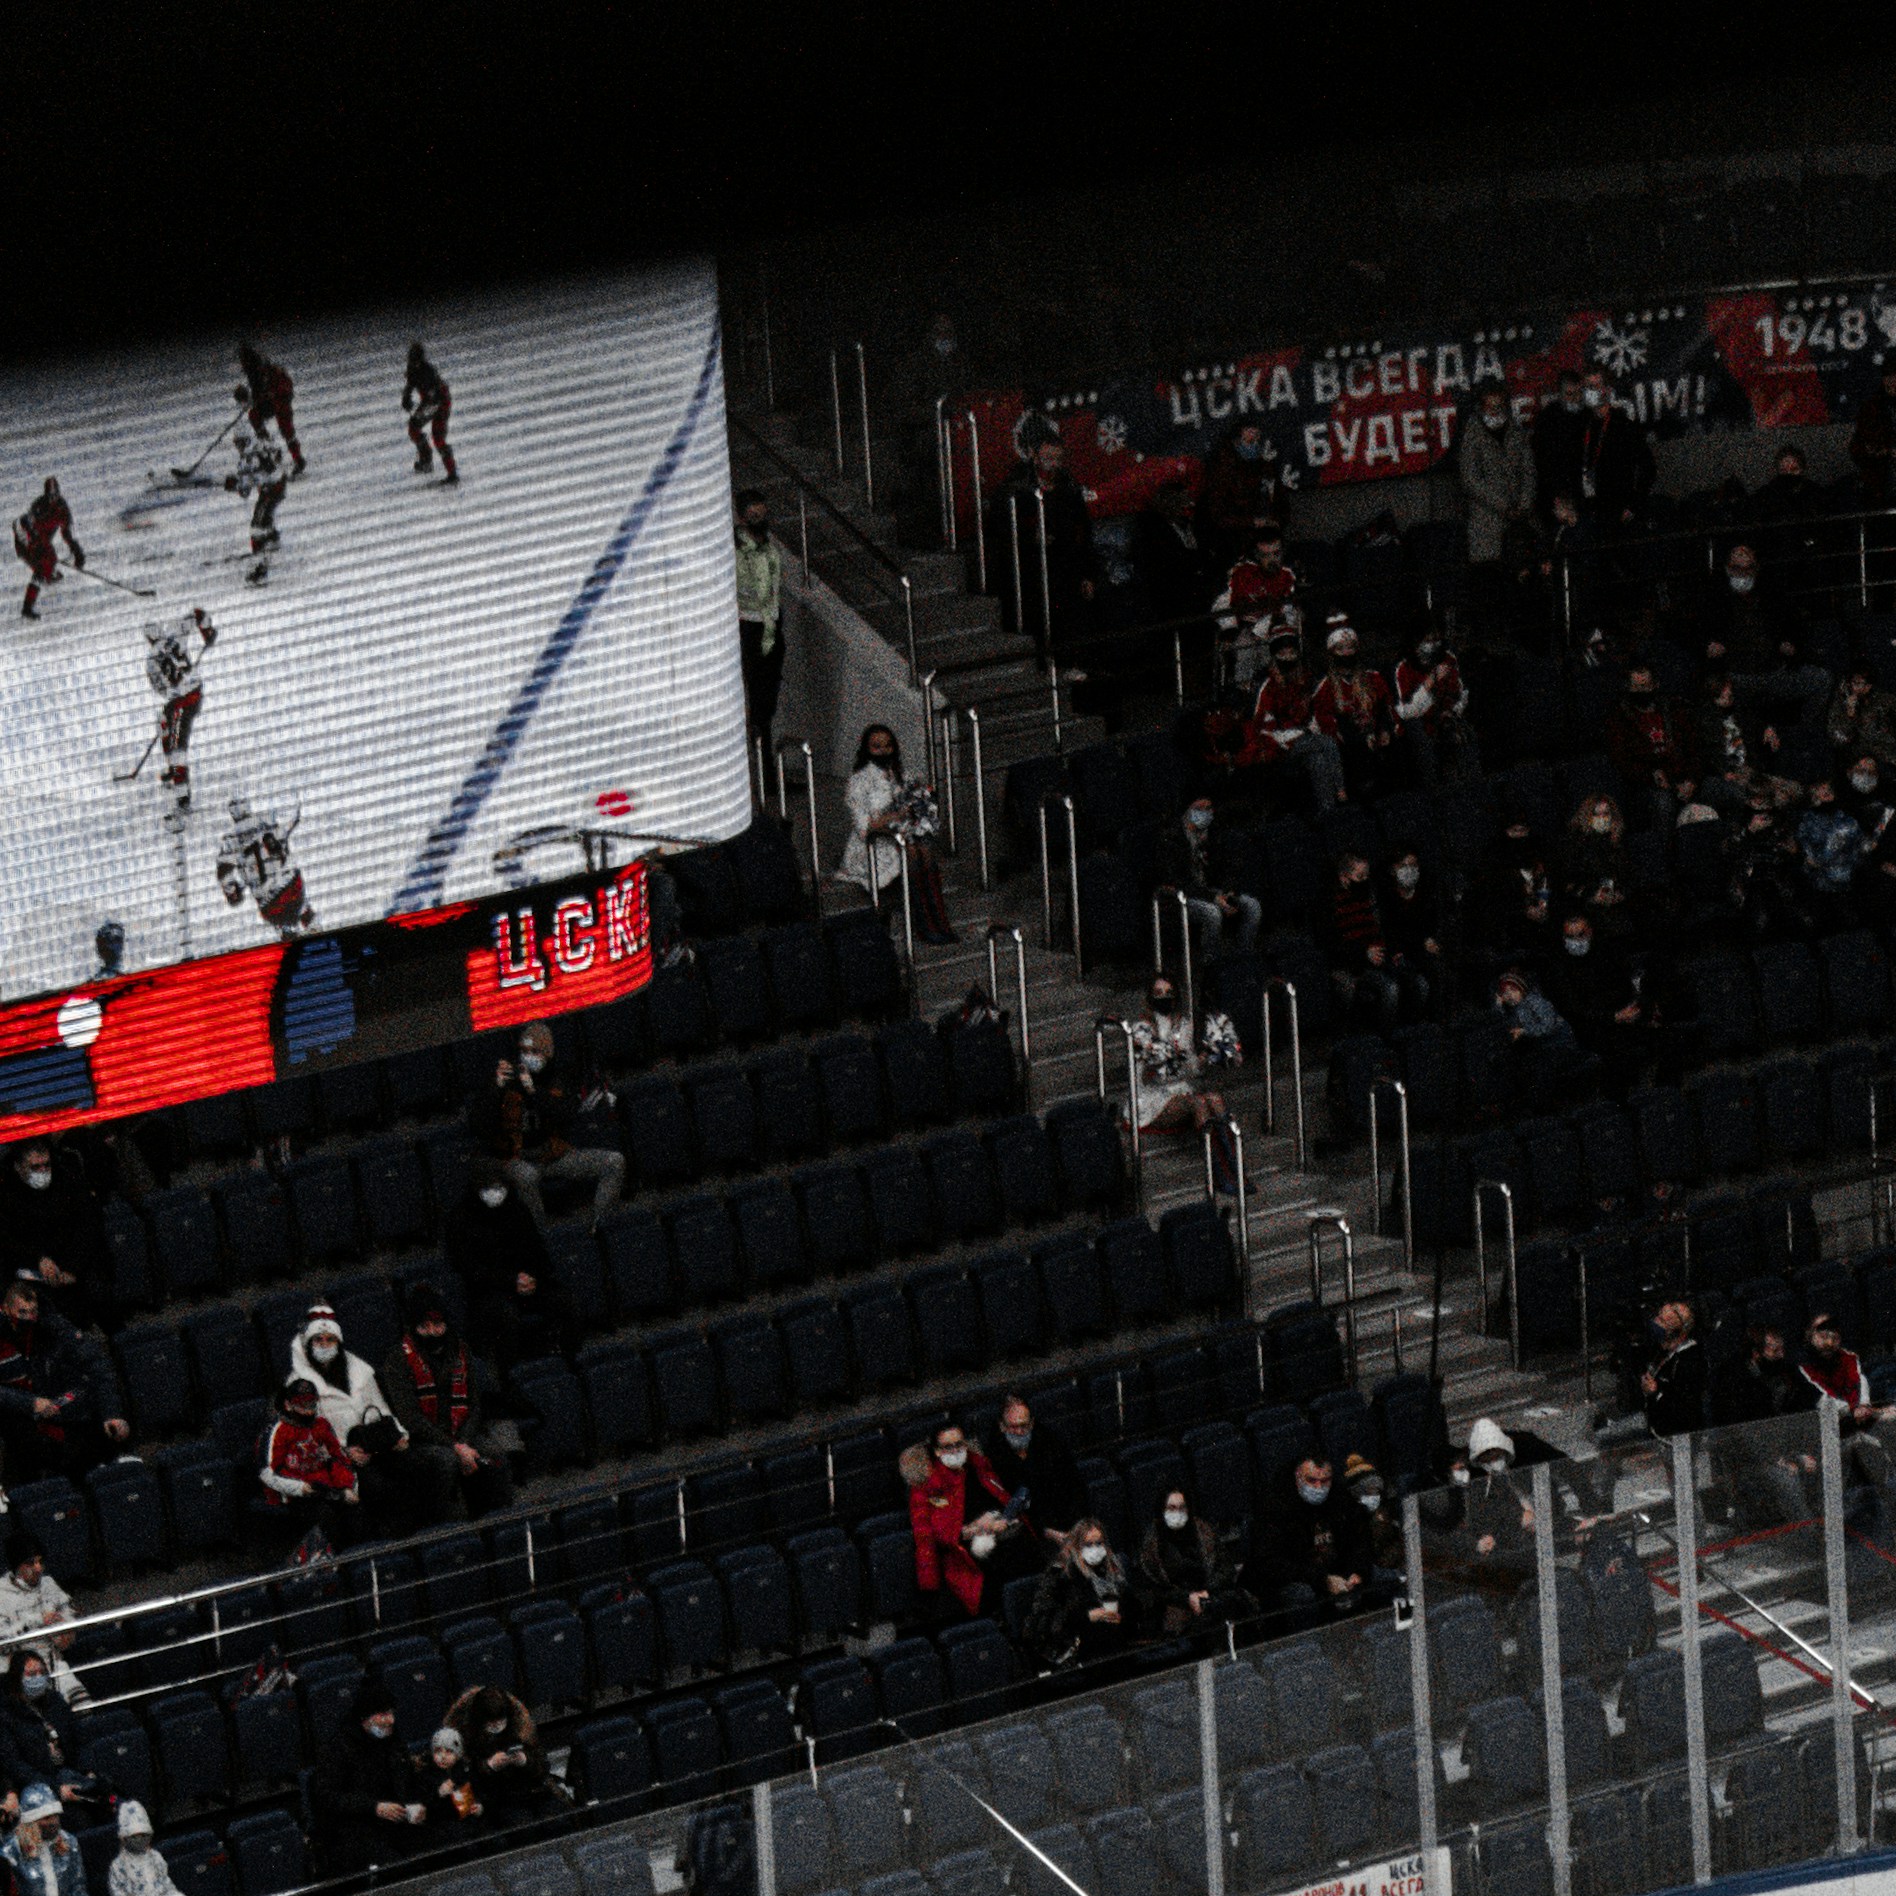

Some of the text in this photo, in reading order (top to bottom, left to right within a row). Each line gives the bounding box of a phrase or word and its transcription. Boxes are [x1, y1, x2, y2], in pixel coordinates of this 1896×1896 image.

[1755, 308, 1868, 356] 1948
[1170, 342, 1505, 429] ЦСКА ВСЕГДА
[1303, 404, 1457, 467] БУДЕТ
